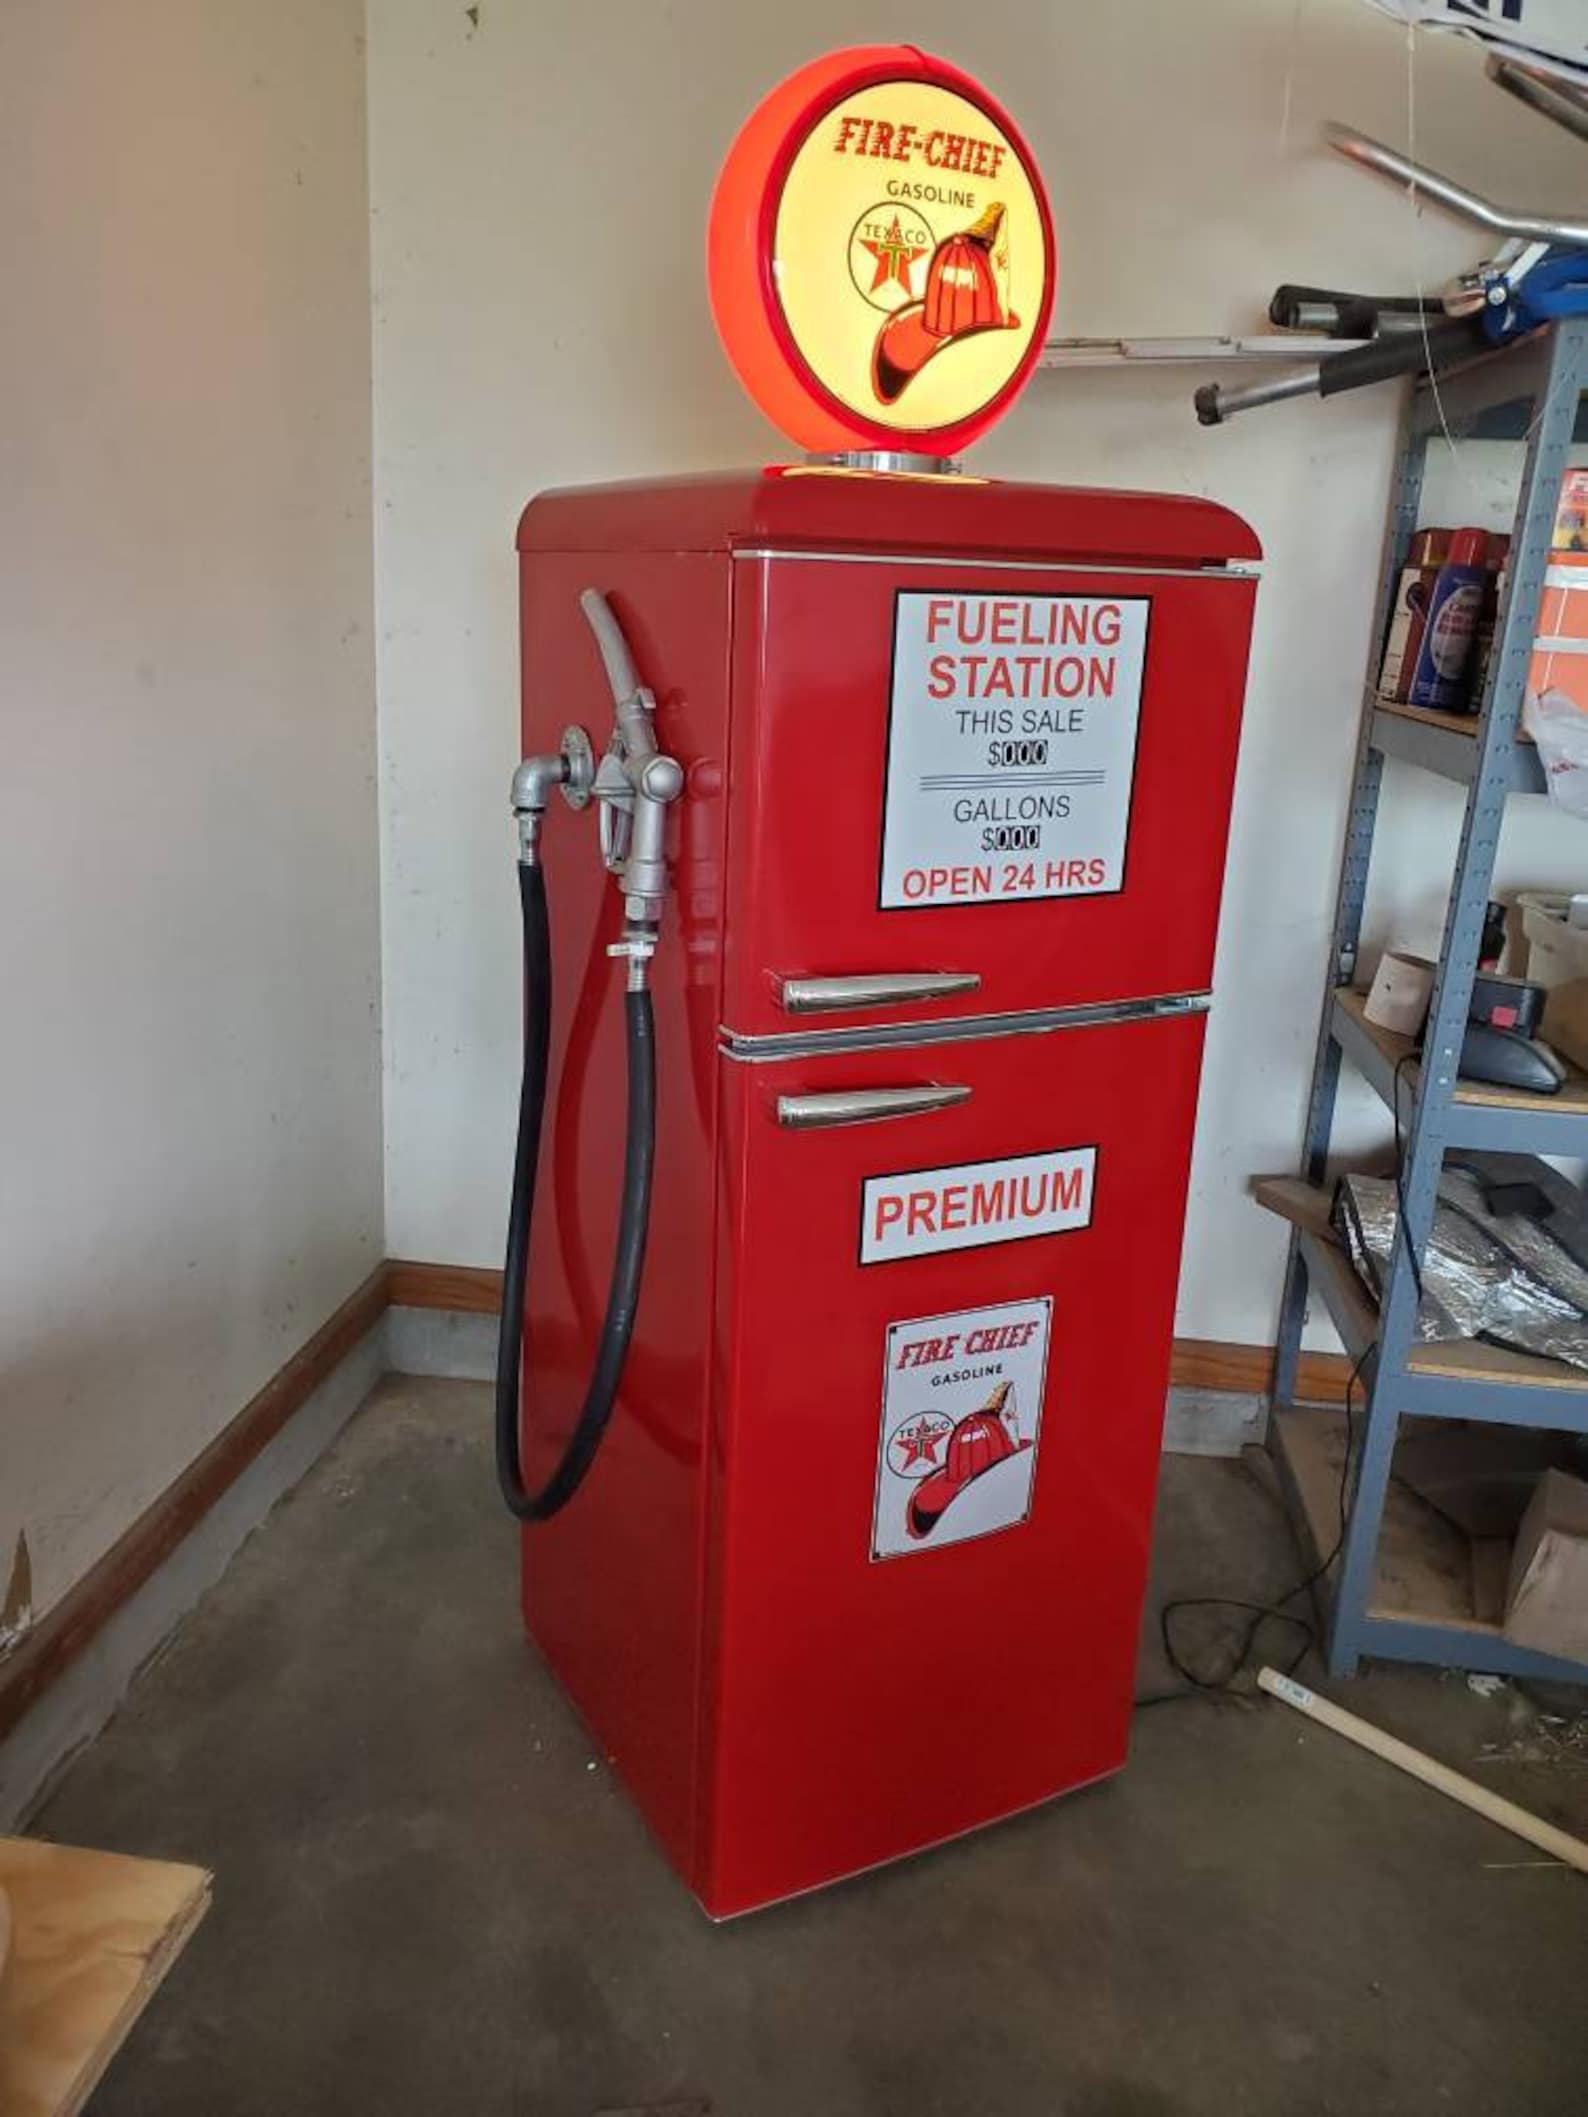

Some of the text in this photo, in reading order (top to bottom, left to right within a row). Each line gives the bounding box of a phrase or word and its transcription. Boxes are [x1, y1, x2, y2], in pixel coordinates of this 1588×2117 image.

[833, 116, 1007, 179] FIRE-CHIEF
[886, 179, 976, 208] GASOLINE
[864, 223, 927, 245] TEXACO
[926, 599, 1122, 646] FUELING
[927, 655, 1116, 699] STATION
[955, 709, 1084, 734] THIS SALE
[953, 795, 1070, 822] GALLONS
[902, 858, 1106, 899] OPEN 24 HRS
[875, 1167, 1083, 1242] PREMIUM
[895, 1321, 1041, 1370] FIRE CHIEF
[930, 1362, 1004, 1387] GASOLINE
[899, 1420, 951, 1439] TEXACO
